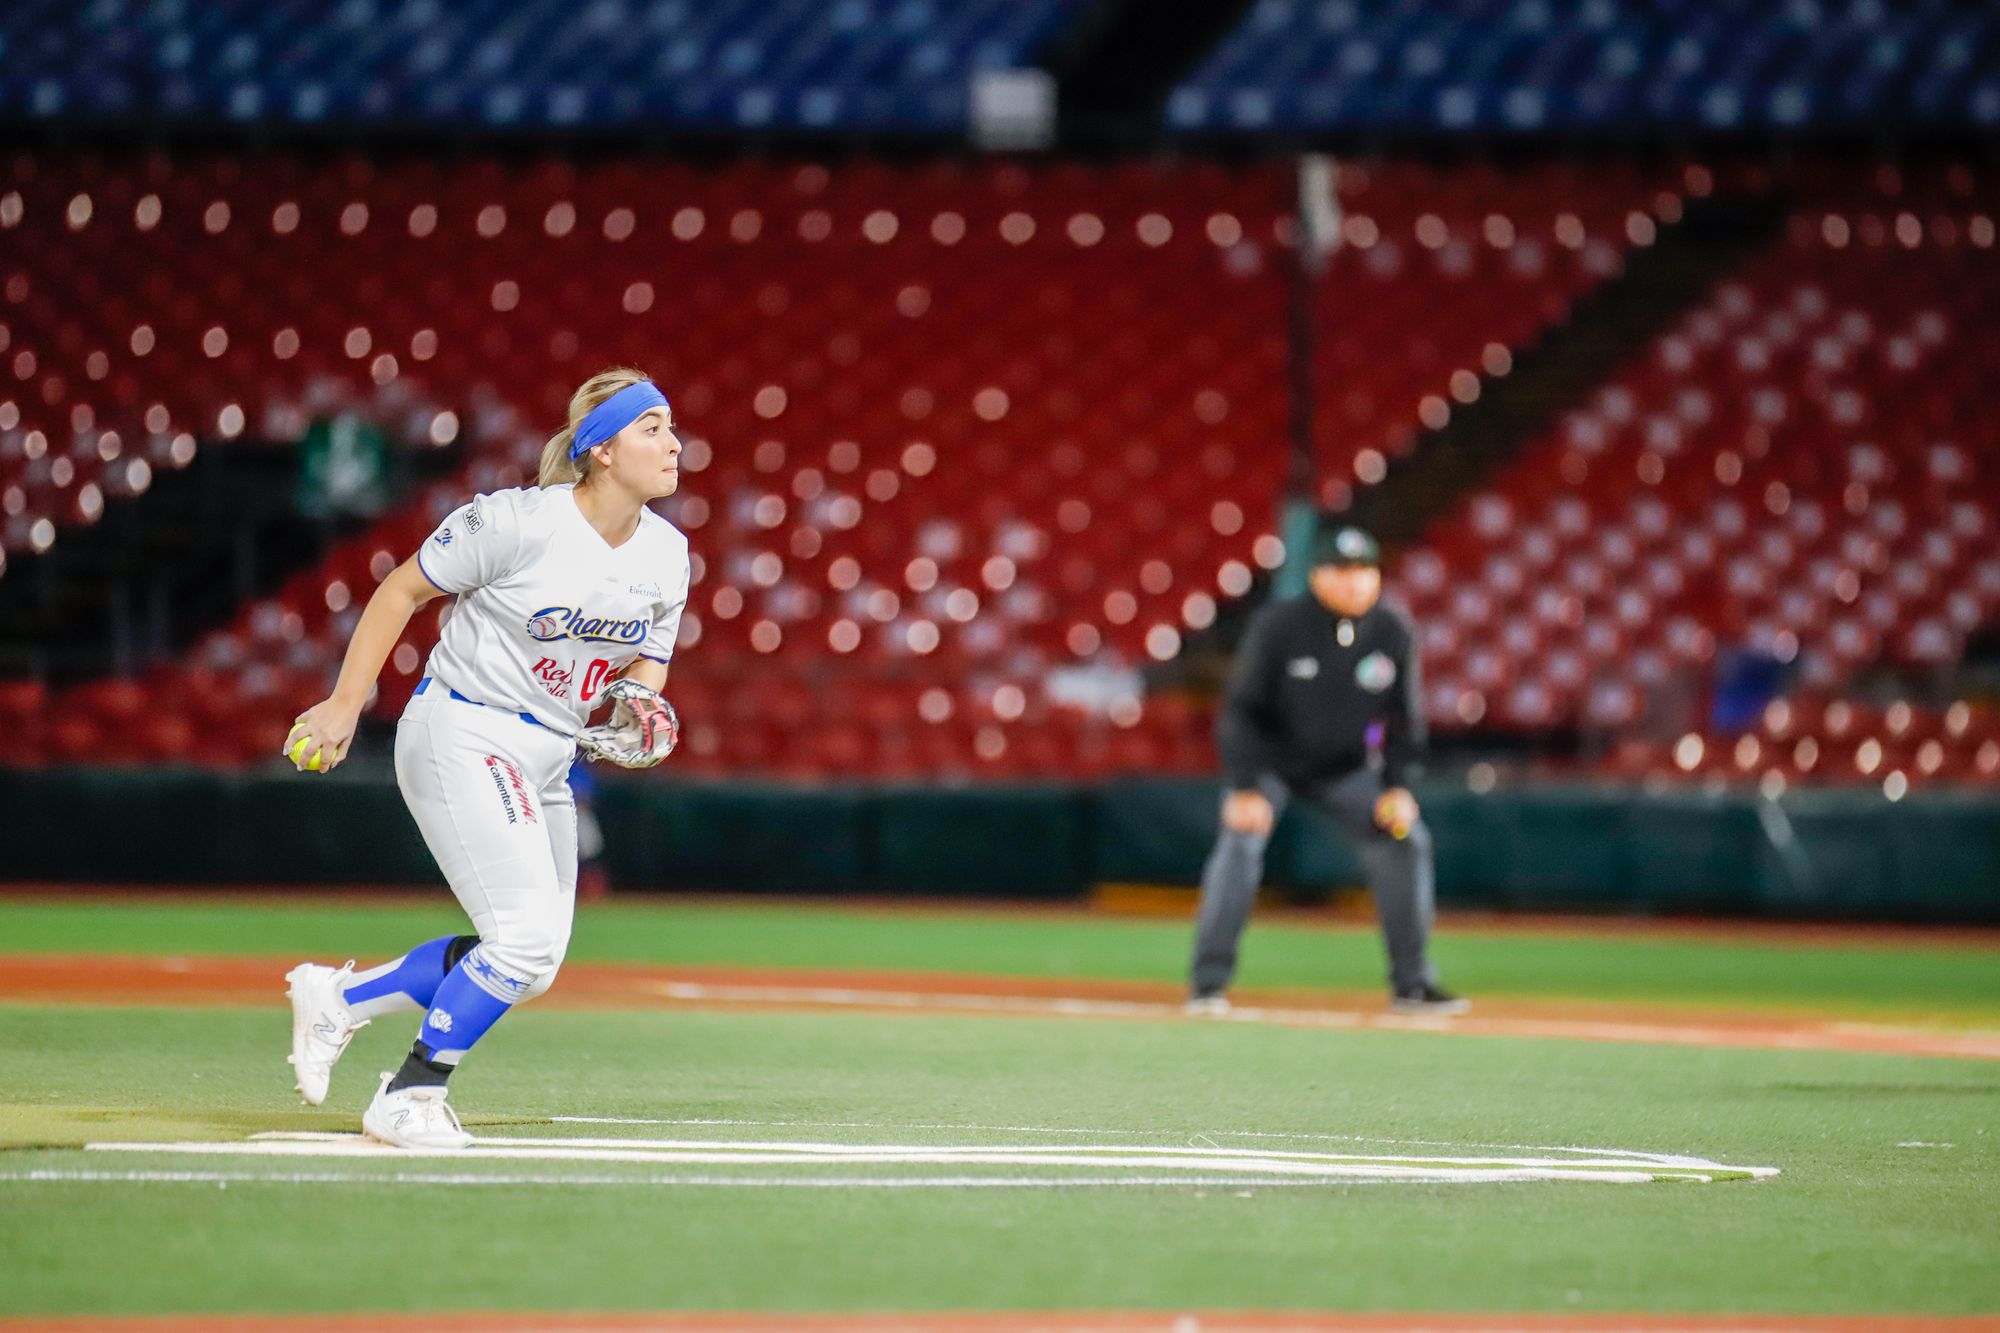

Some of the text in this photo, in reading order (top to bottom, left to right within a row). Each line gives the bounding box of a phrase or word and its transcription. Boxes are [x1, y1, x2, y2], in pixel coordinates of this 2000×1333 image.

[527, 607, 649, 645] Charros
[531, 656, 575, 686] Red
[540, 682, 568, 699] ola
[489, 766, 518, 825] caliente.mx
